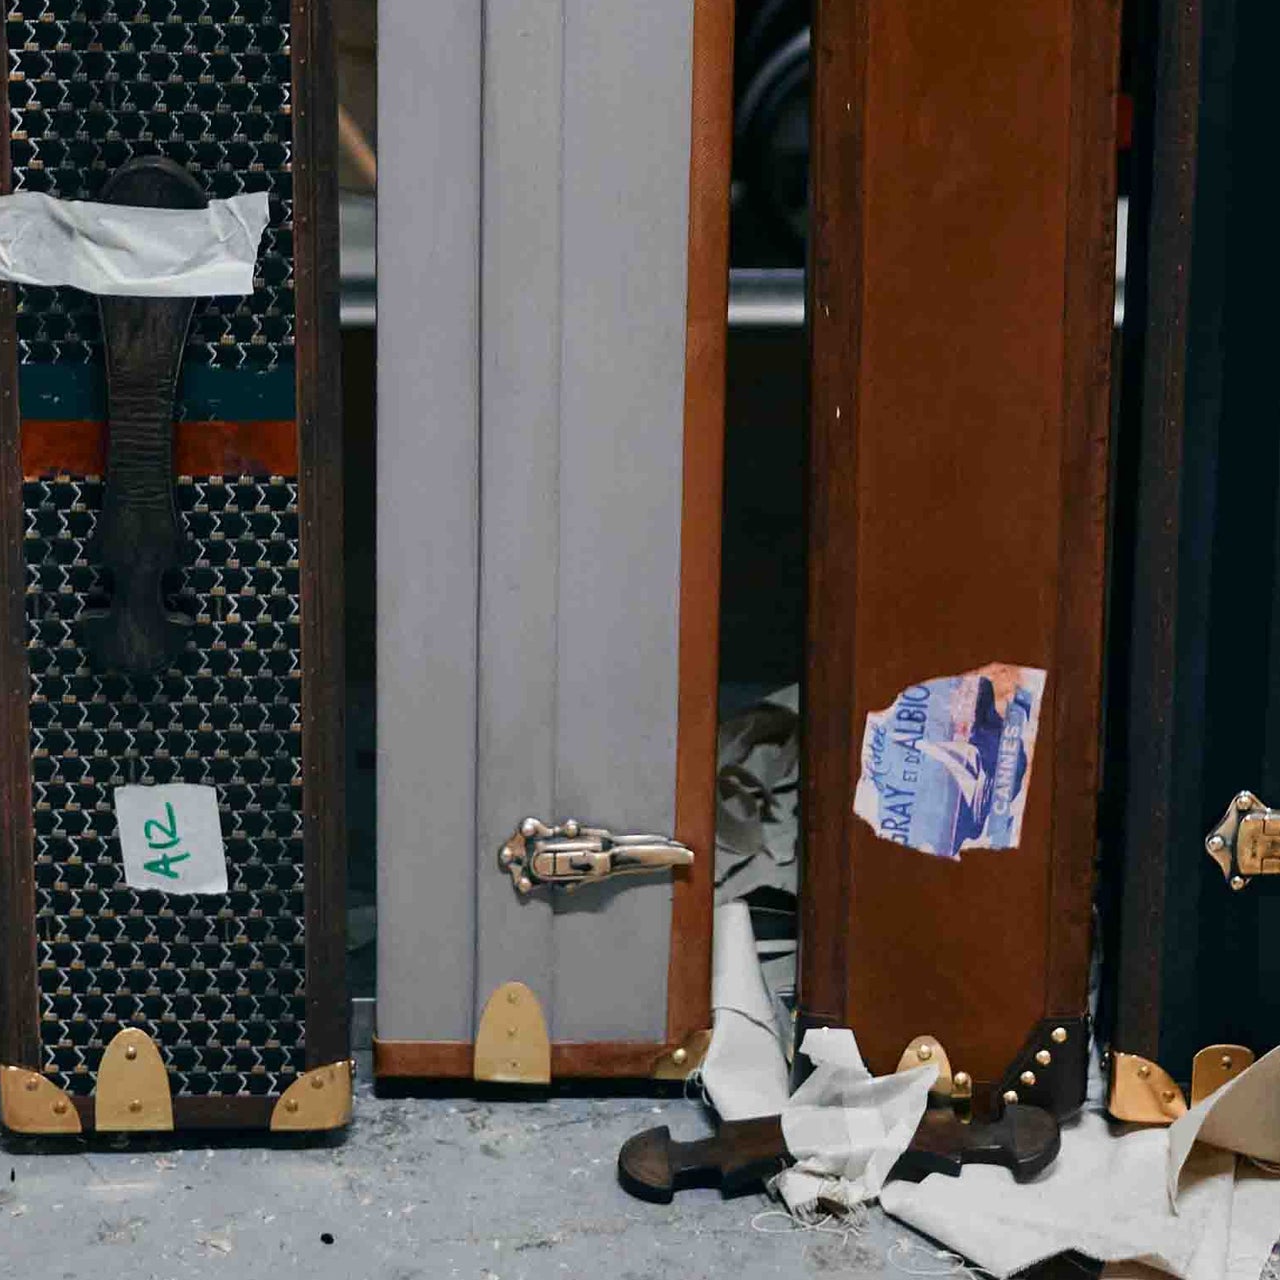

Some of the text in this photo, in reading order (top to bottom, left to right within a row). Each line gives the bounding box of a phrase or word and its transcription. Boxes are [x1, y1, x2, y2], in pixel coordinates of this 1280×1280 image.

[902, 769, 919, 783] ET
[993, 725, 1019, 814] CANNES
[143, 801, 192, 880] A12
